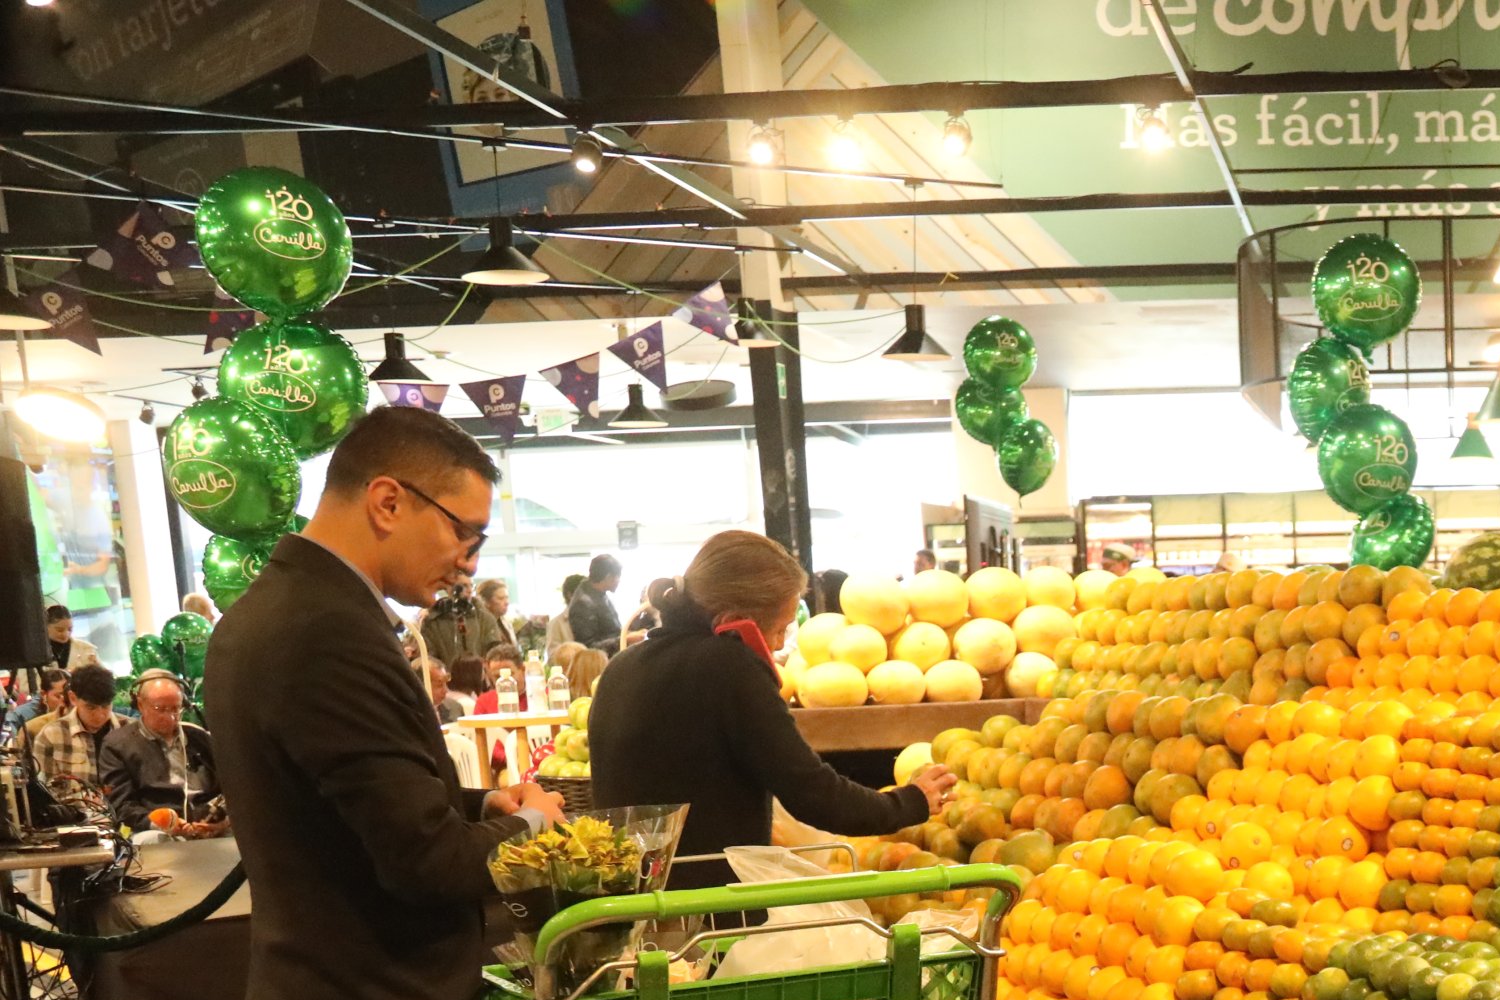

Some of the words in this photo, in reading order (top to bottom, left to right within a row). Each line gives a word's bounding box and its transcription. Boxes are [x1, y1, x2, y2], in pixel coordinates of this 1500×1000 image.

[1256, 94, 1399, 154] fácil,
[265, 187, 314, 221] 120
[1346, 255, 1390, 285] 120
[634, 350, 662, 370] Puntos
[484, 402, 516, 414] Puntos
[1374, 434, 1409, 464] 120
[172, 472, 232, 495] Carulla
